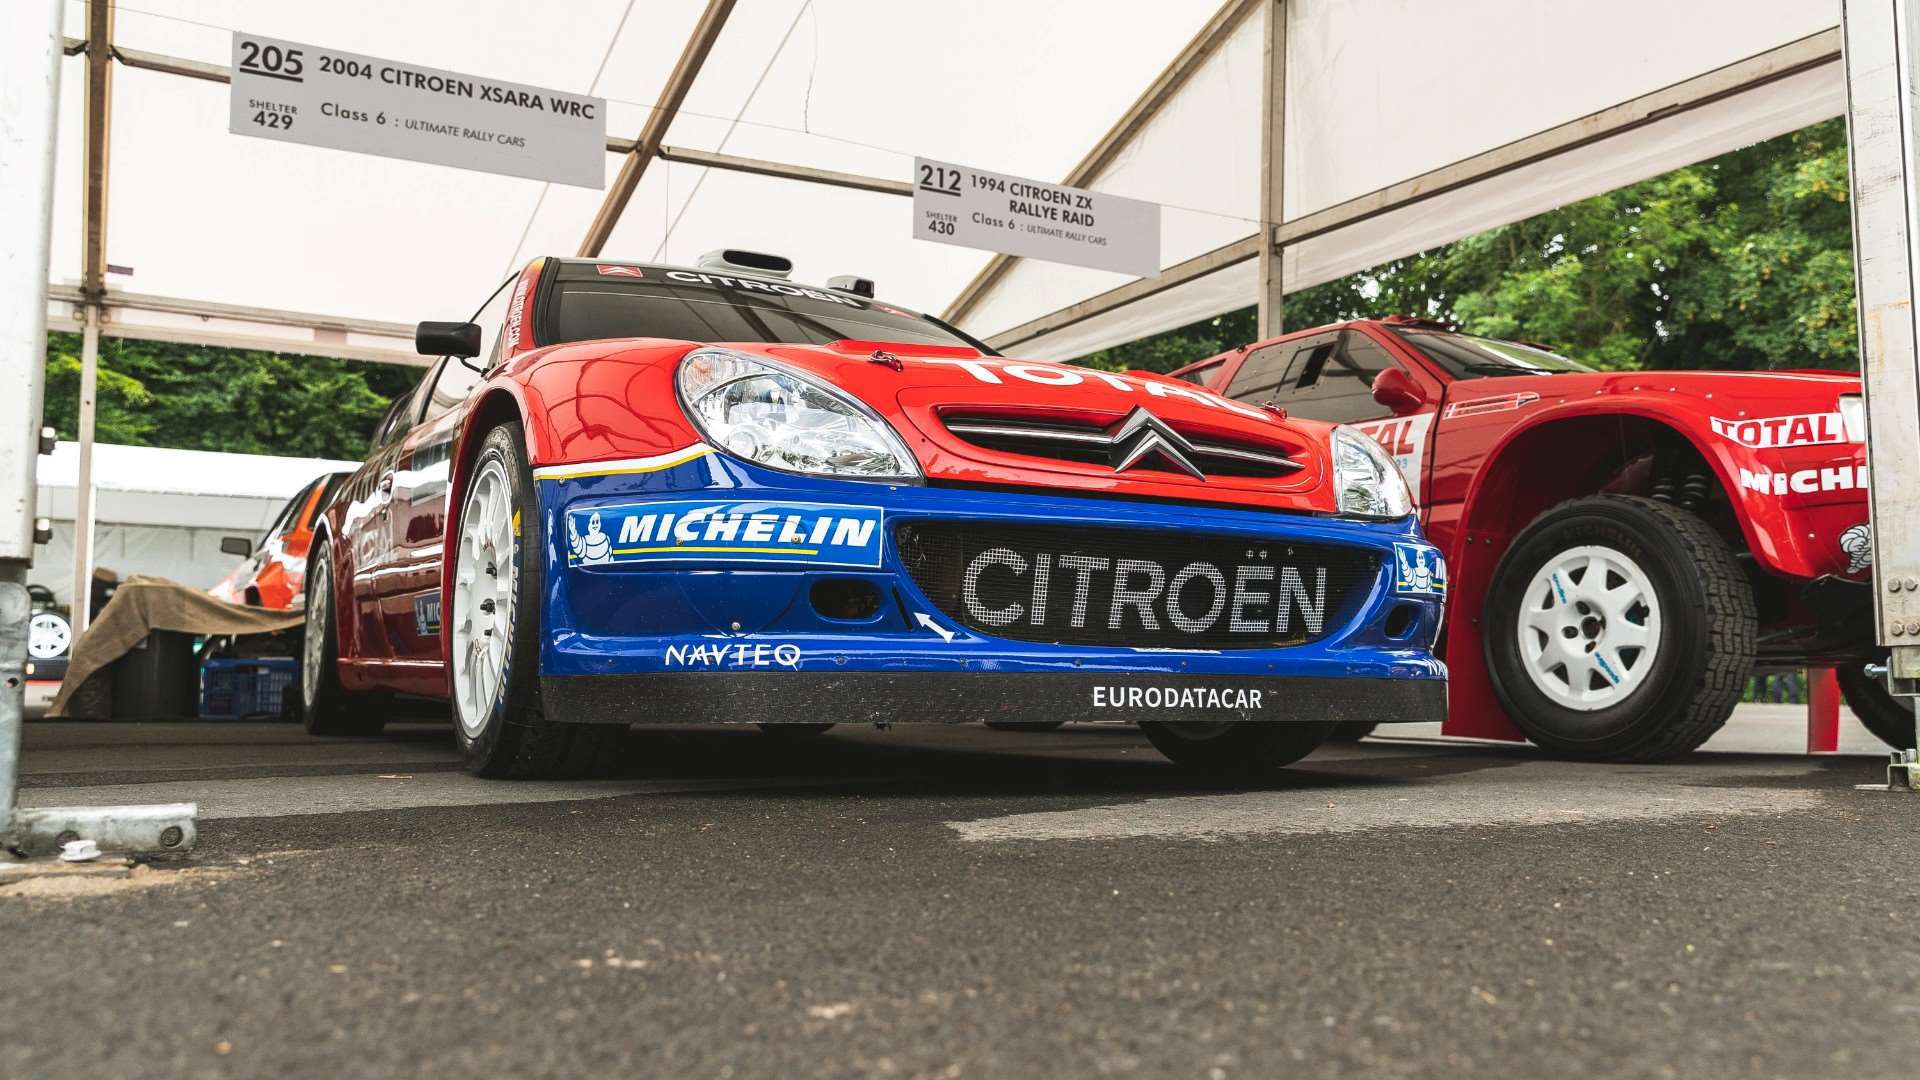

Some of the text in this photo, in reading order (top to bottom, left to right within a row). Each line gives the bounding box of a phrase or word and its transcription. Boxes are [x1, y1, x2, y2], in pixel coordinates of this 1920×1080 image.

[239, 40, 304, 76] 205
[319, 55, 595, 120] 2004 CITROEN XSARA WRC
[249, 99, 298, 115] SHELTER
[252, 111, 294, 130] 429
[320, 102, 369, 123] Class
[376, 110, 387, 126] 6
[405, 118, 461, 138] ULTIMATE
[463, 127, 495, 143] RALLY
[497, 133, 526, 148] CARS
[920, 164, 962, 191] 212
[970, 174, 1093, 210] 1994 CITROEN ZX
[925, 210, 958, 223] SHELTER
[1009, 199, 1095, 227] RALLYE RAID
[928, 221, 955, 236] 430
[972, 212, 1004, 228] Class
[1007, 218, 1016, 231] 6
[1026, 224, 1064, 239] ULTIMATE
[1065, 231, 1087, 243] RALLY
[1087, 234, 1107, 247] CARS
[921, 358, 1272, 421] TOTAL
[1714, 415, 1838, 446] TOTAL
[618, 512, 876, 548] MICHELIN
[664, 643, 801, 671] NAVTEQ
[1092, 685, 1263, 710] EURODATACAR
